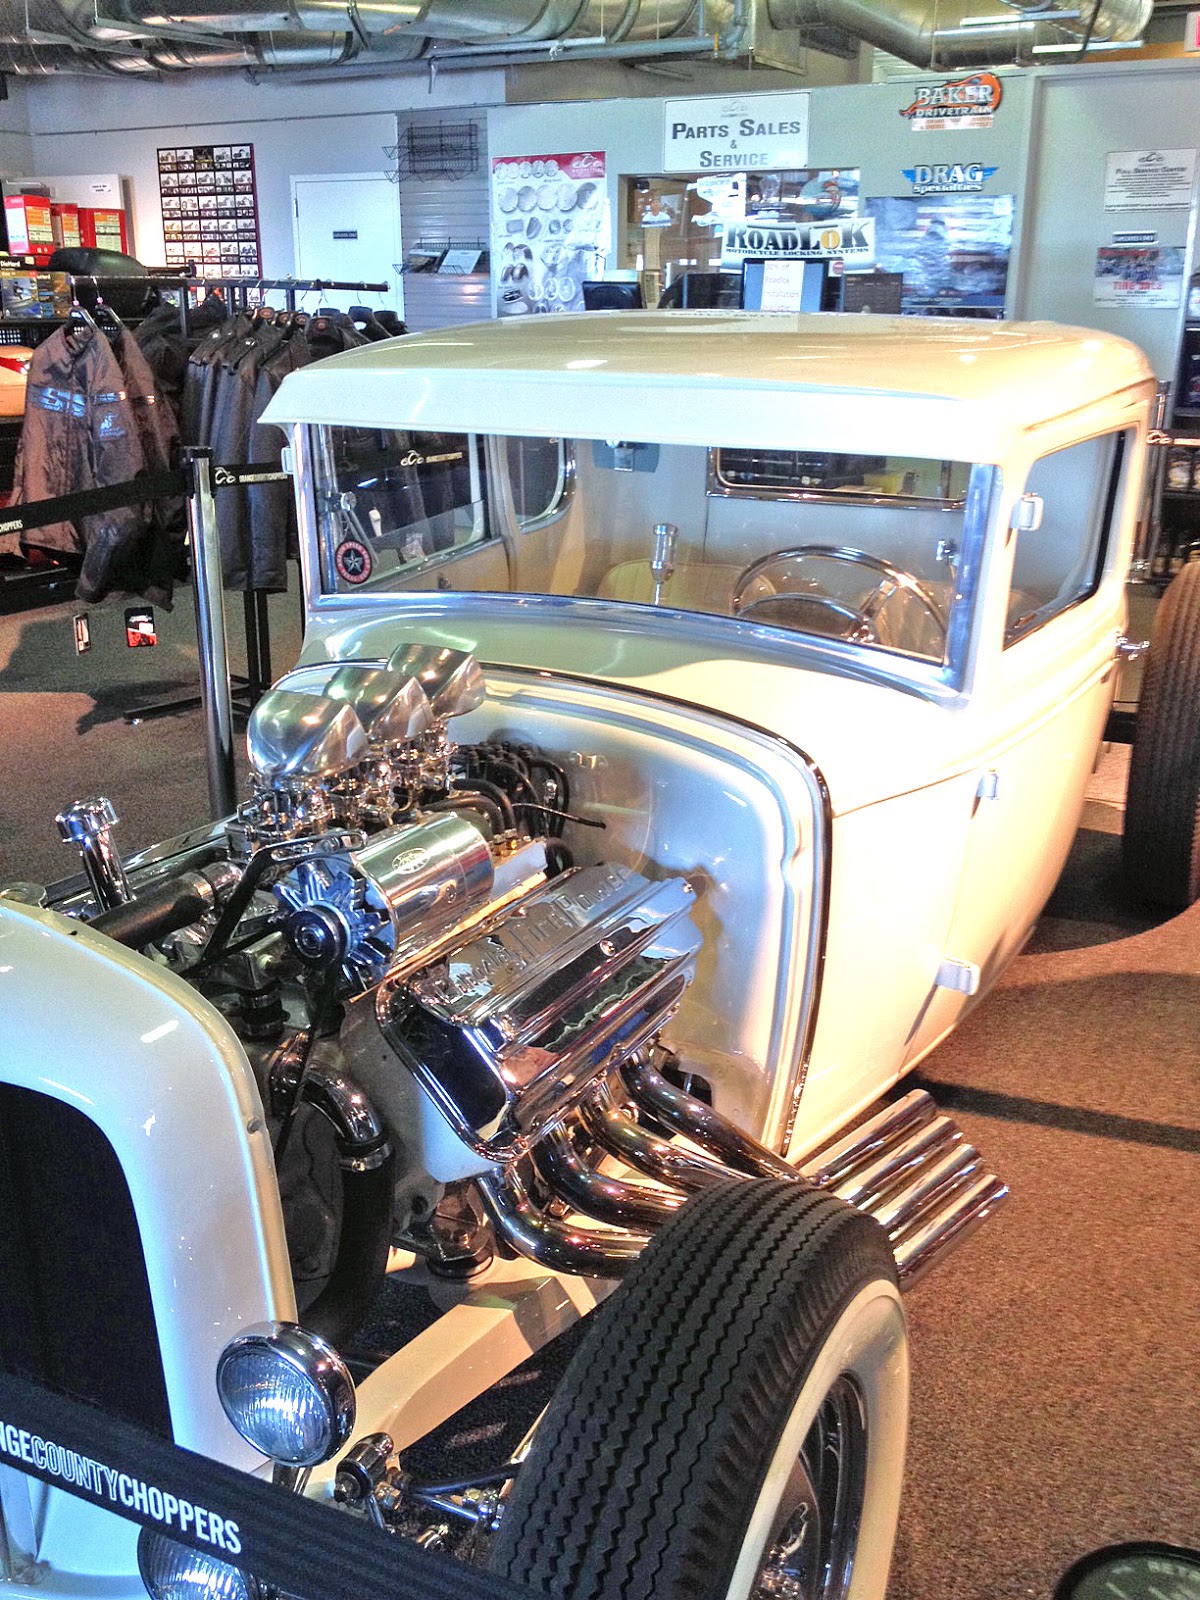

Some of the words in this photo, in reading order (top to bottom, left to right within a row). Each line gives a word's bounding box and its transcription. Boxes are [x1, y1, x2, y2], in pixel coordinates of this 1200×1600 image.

[915, 86, 993, 106] BAKER
[672, 122, 729, 139] PARTS
[739, 118, 801, 136] SALES
[730, 139, 737, 149] &
[700, 150, 768, 167] SERVICE
[914, 163, 984, 183] DRAG
[726, 221, 871, 251] ROADLOK
[726, 248, 780, 256] MOTORCYCLE
[827, 247, 870, 255] SYSTEMS
